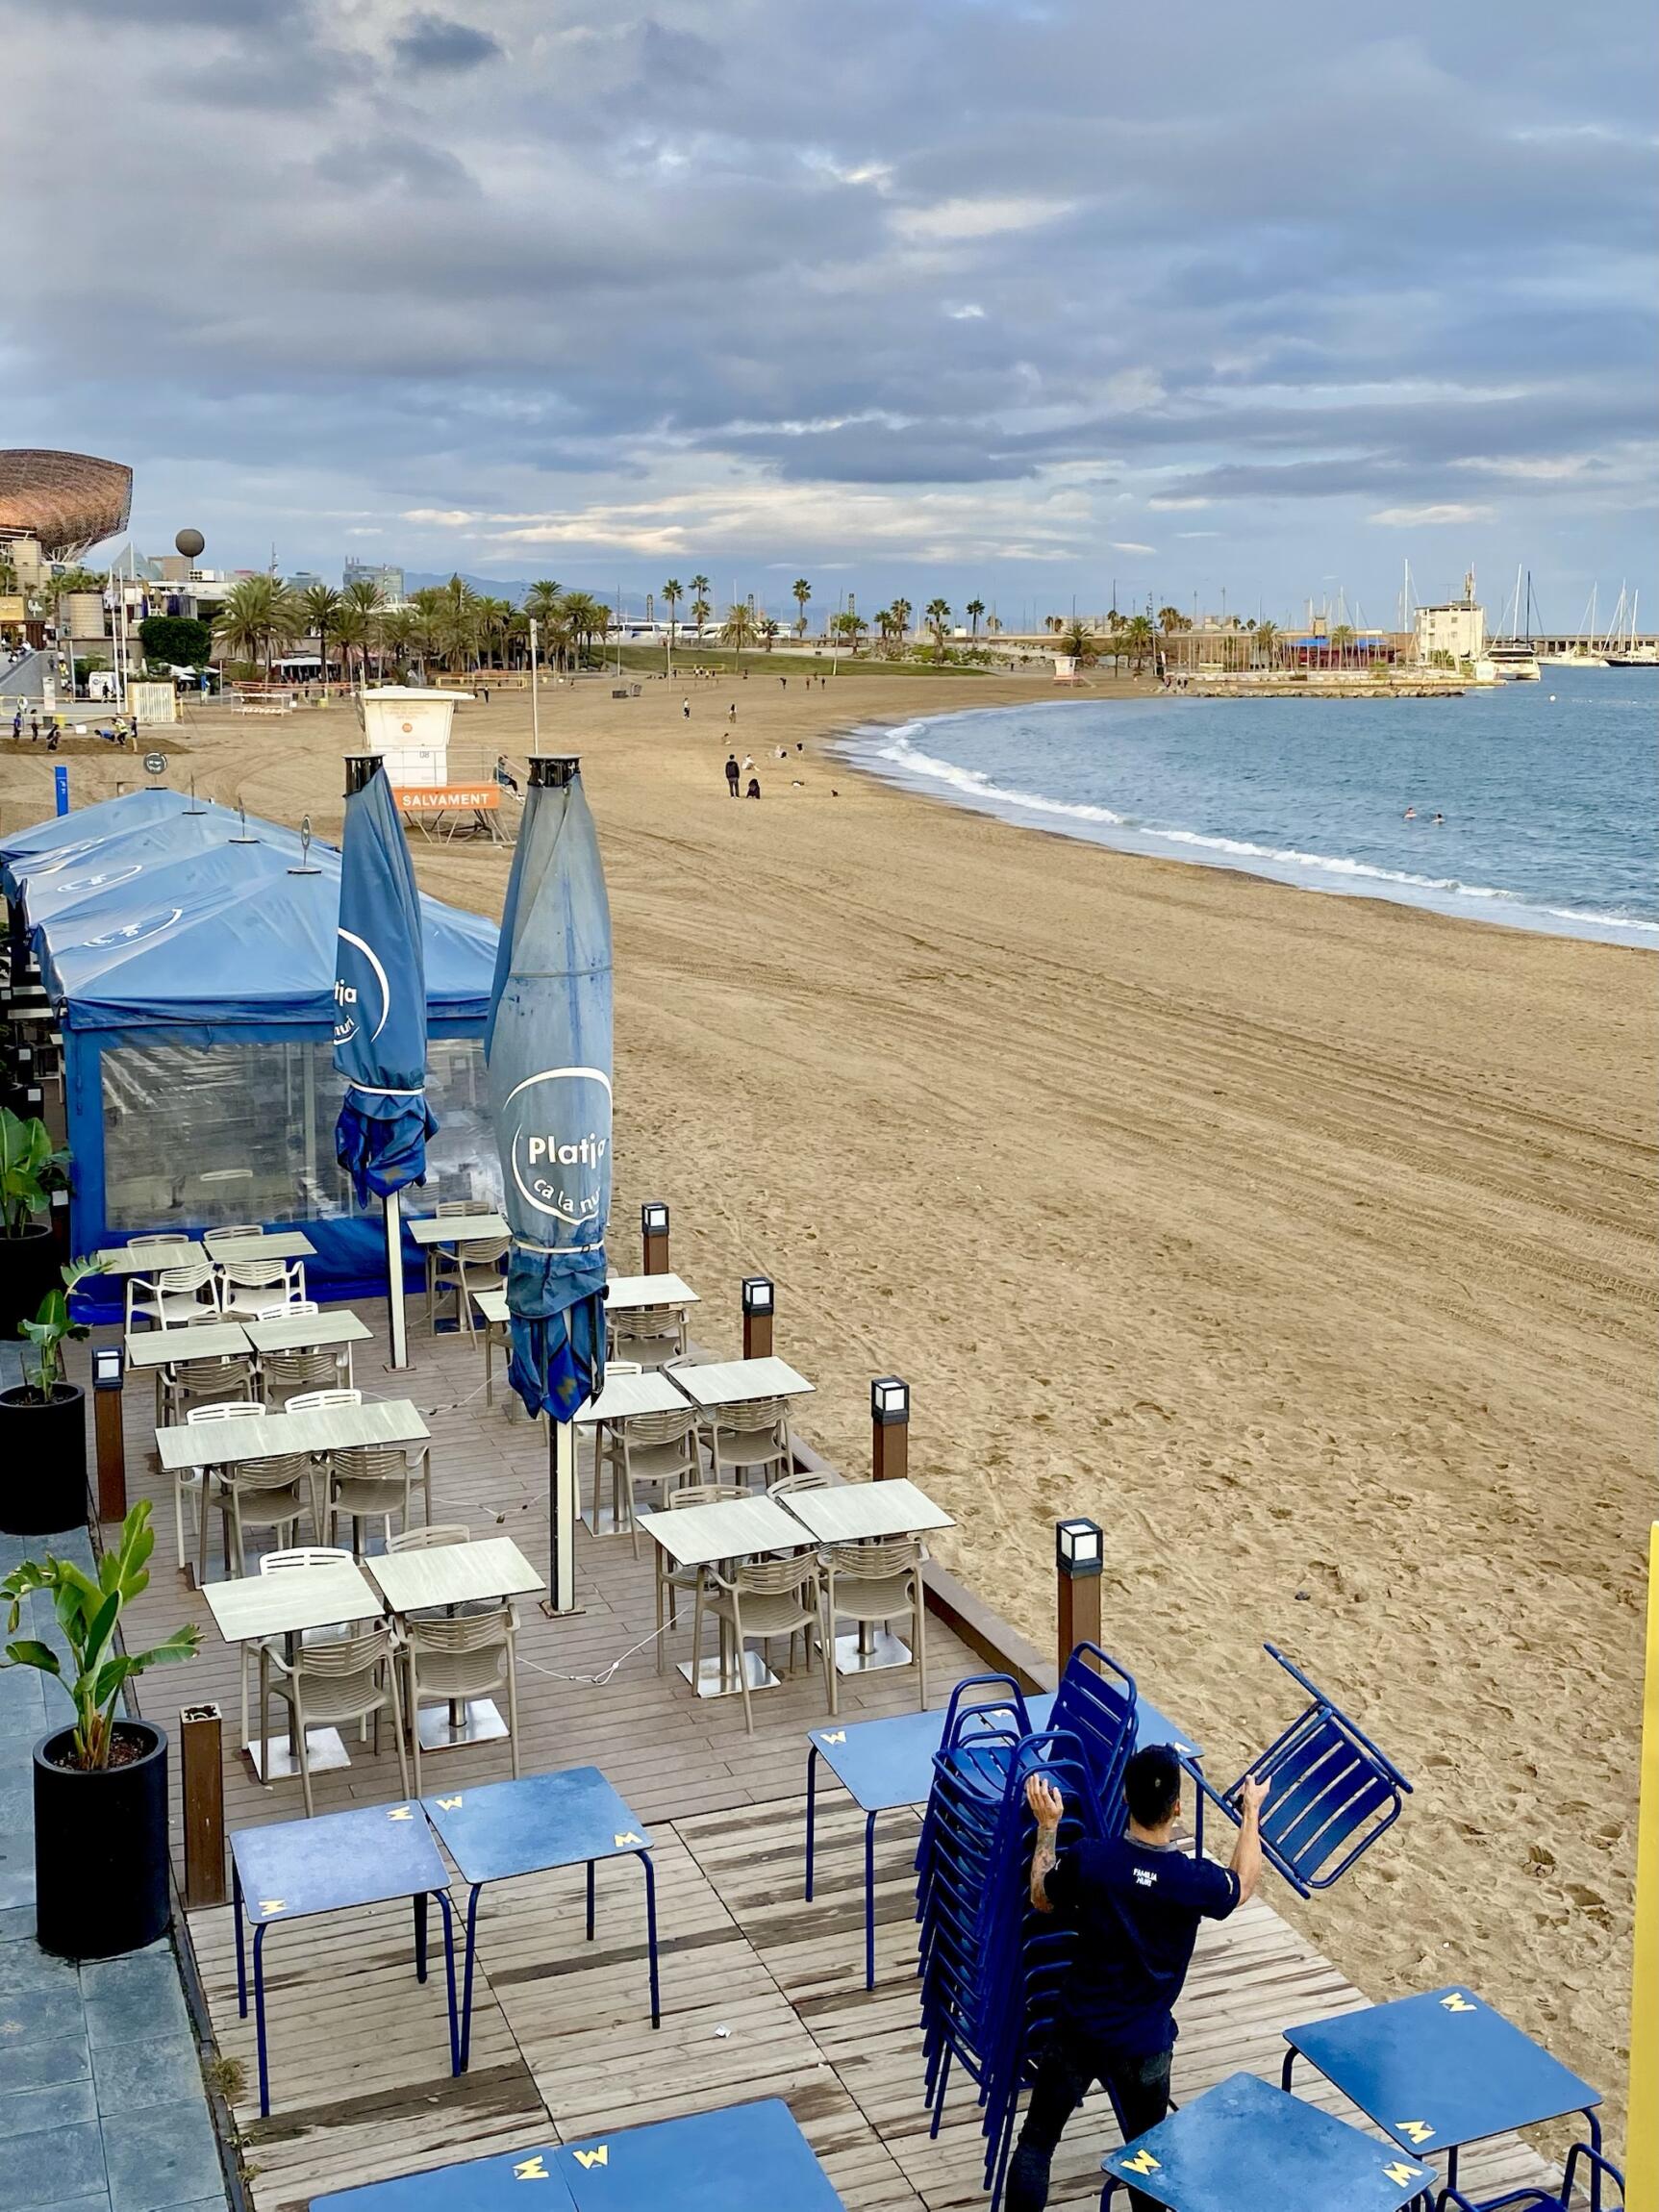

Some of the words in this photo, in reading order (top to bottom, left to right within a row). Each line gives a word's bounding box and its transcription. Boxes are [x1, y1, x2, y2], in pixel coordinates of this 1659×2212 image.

[402, 793, 490, 807] SALVAMENT
[534, 1179, 555, 1199] ca
[558, 1191, 574, 1213] la
[580, 1185, 600, 1213] nu
